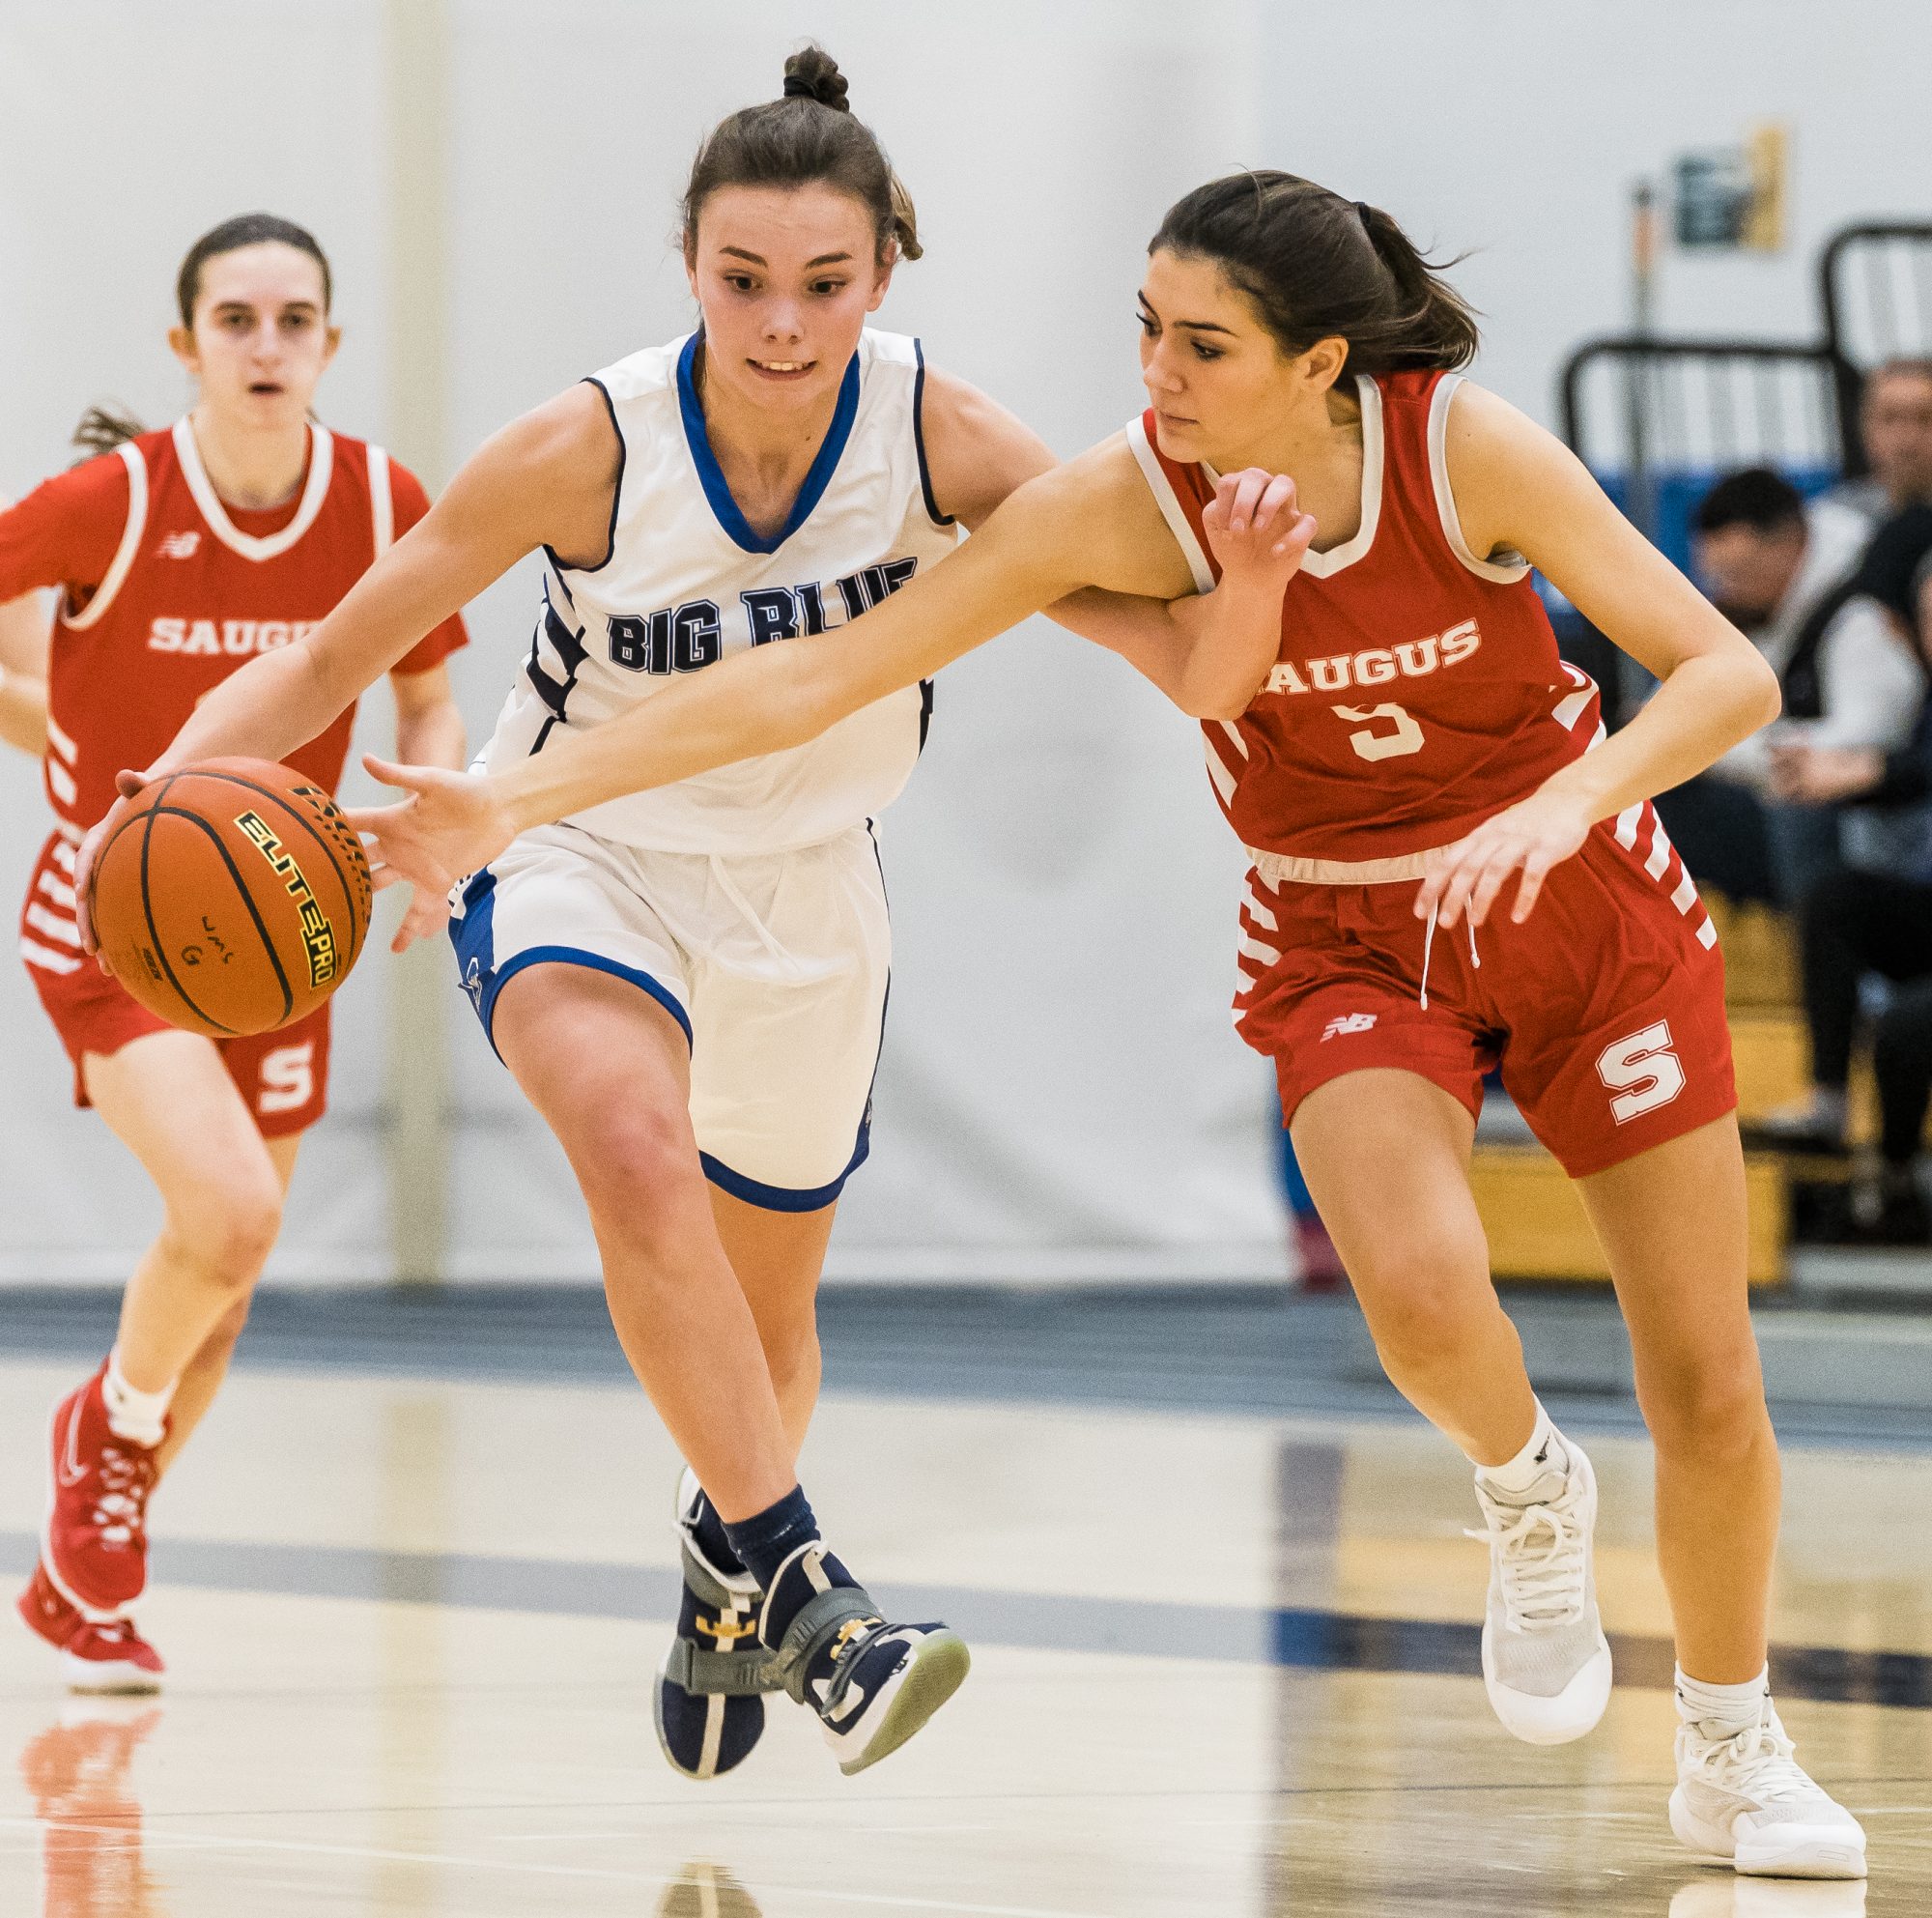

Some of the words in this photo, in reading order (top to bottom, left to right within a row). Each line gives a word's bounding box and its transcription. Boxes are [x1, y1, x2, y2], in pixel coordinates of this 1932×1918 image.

[148, 616, 323, 655] SAUG
[608, 599, 723, 675] BIG
[1257, 616, 1482, 695] AUGUS
[233, 809, 328, 937] ELITE
[305, 925, 335, 987] PRO
[258, 1042, 313, 1113] S
[1595, 1018, 1686, 1127] S
